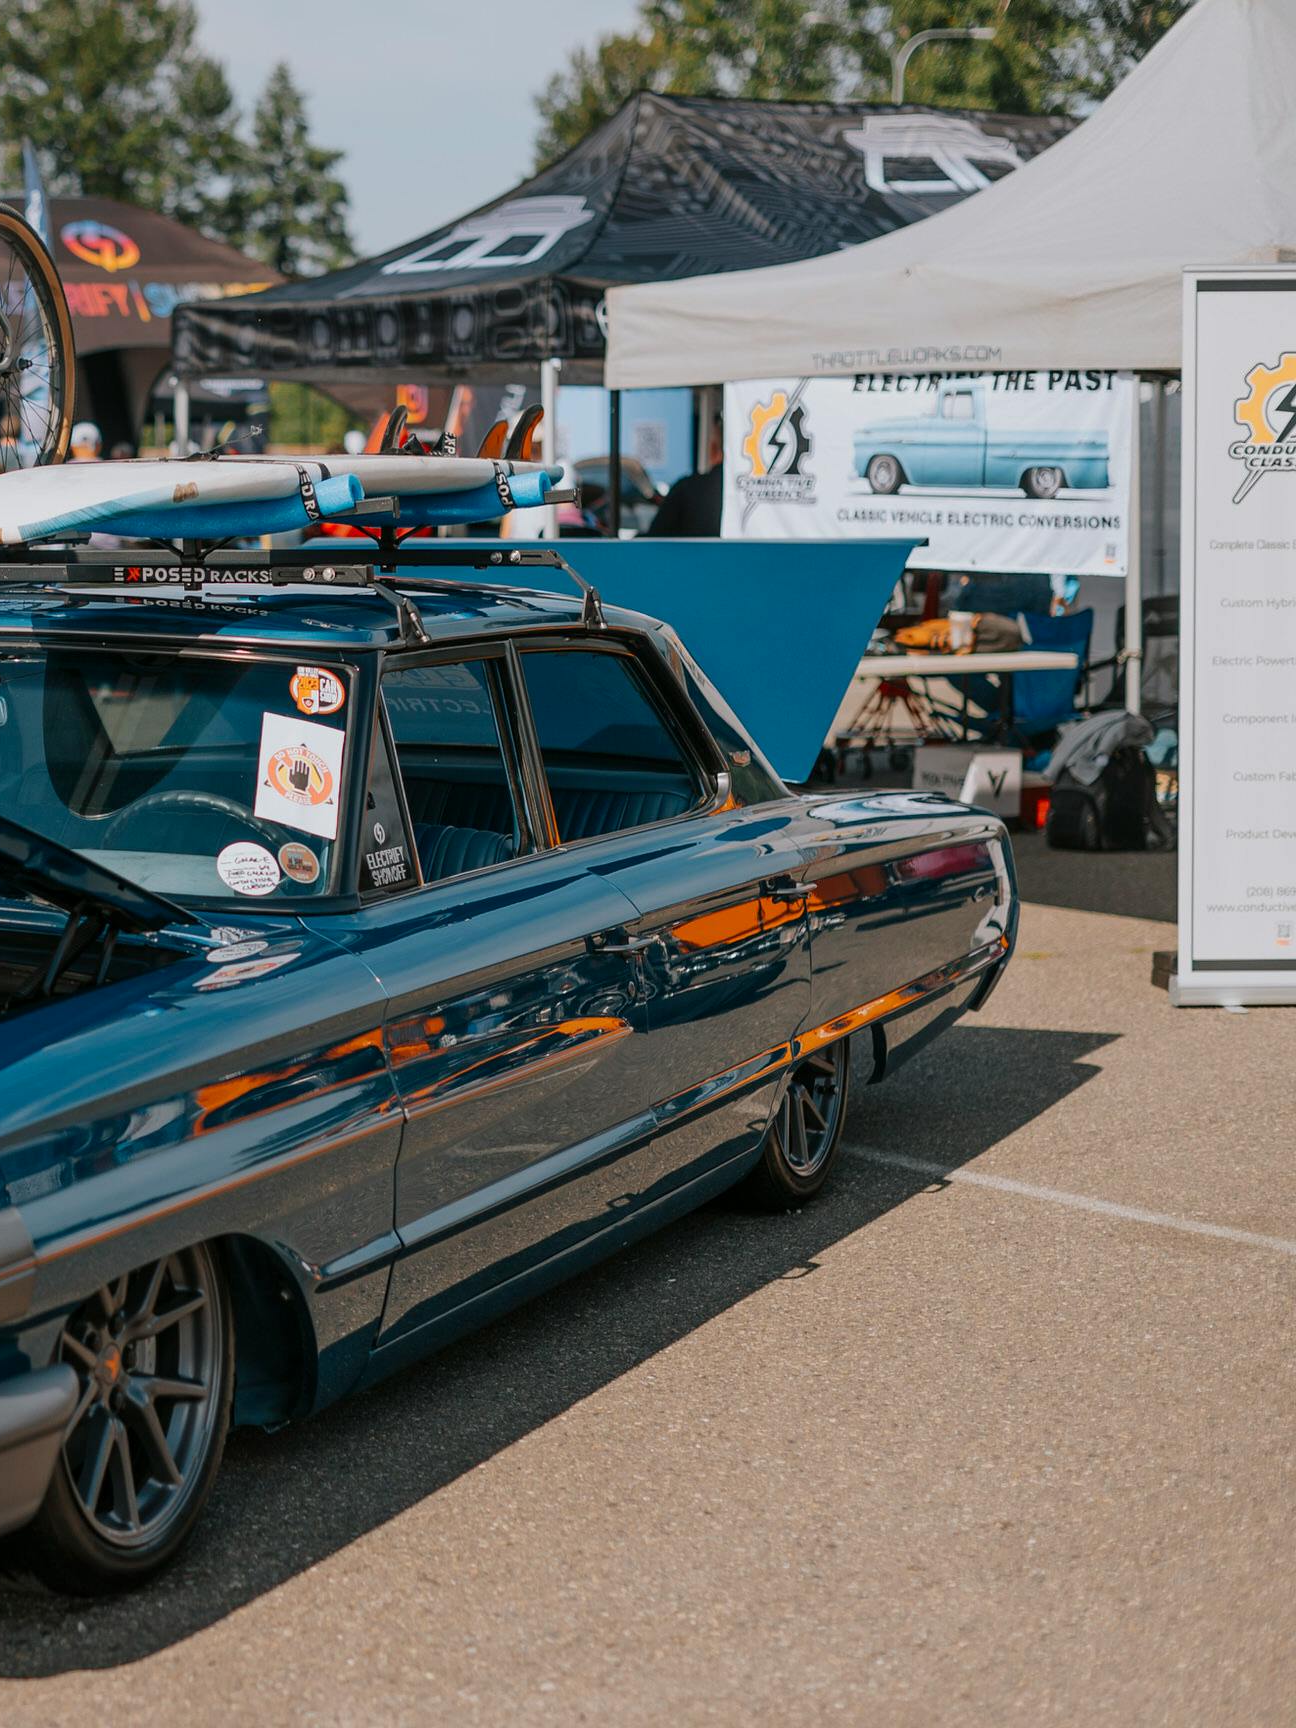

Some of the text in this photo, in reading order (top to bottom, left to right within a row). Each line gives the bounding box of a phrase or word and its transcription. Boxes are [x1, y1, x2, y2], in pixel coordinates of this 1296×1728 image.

[992, 370, 1036, 391] THE
[1048, 370, 1119, 391] PAST
[1249, 457, 1296, 467] CLAS
[837, 508, 1122, 530] CLASSIC VEHICLE ELECTRIC CONVERSIONS
[1210, 540, 1254, 552] Complete
[1257, 539, 1291, 550] Classic
[114, 567, 205, 582] EXPOSED
[210, 570, 269, 583] RACKS
[1220, 598, 1264, 608] Custom
[1212, 656, 1296, 667] Electric Powert
[1222, 714, 1289, 725] Component
[1233, 771, 1275, 782] Custom
[1226, 829, 1269, 840] Product
[366, 846, 404, 870] ELECTRIFY
